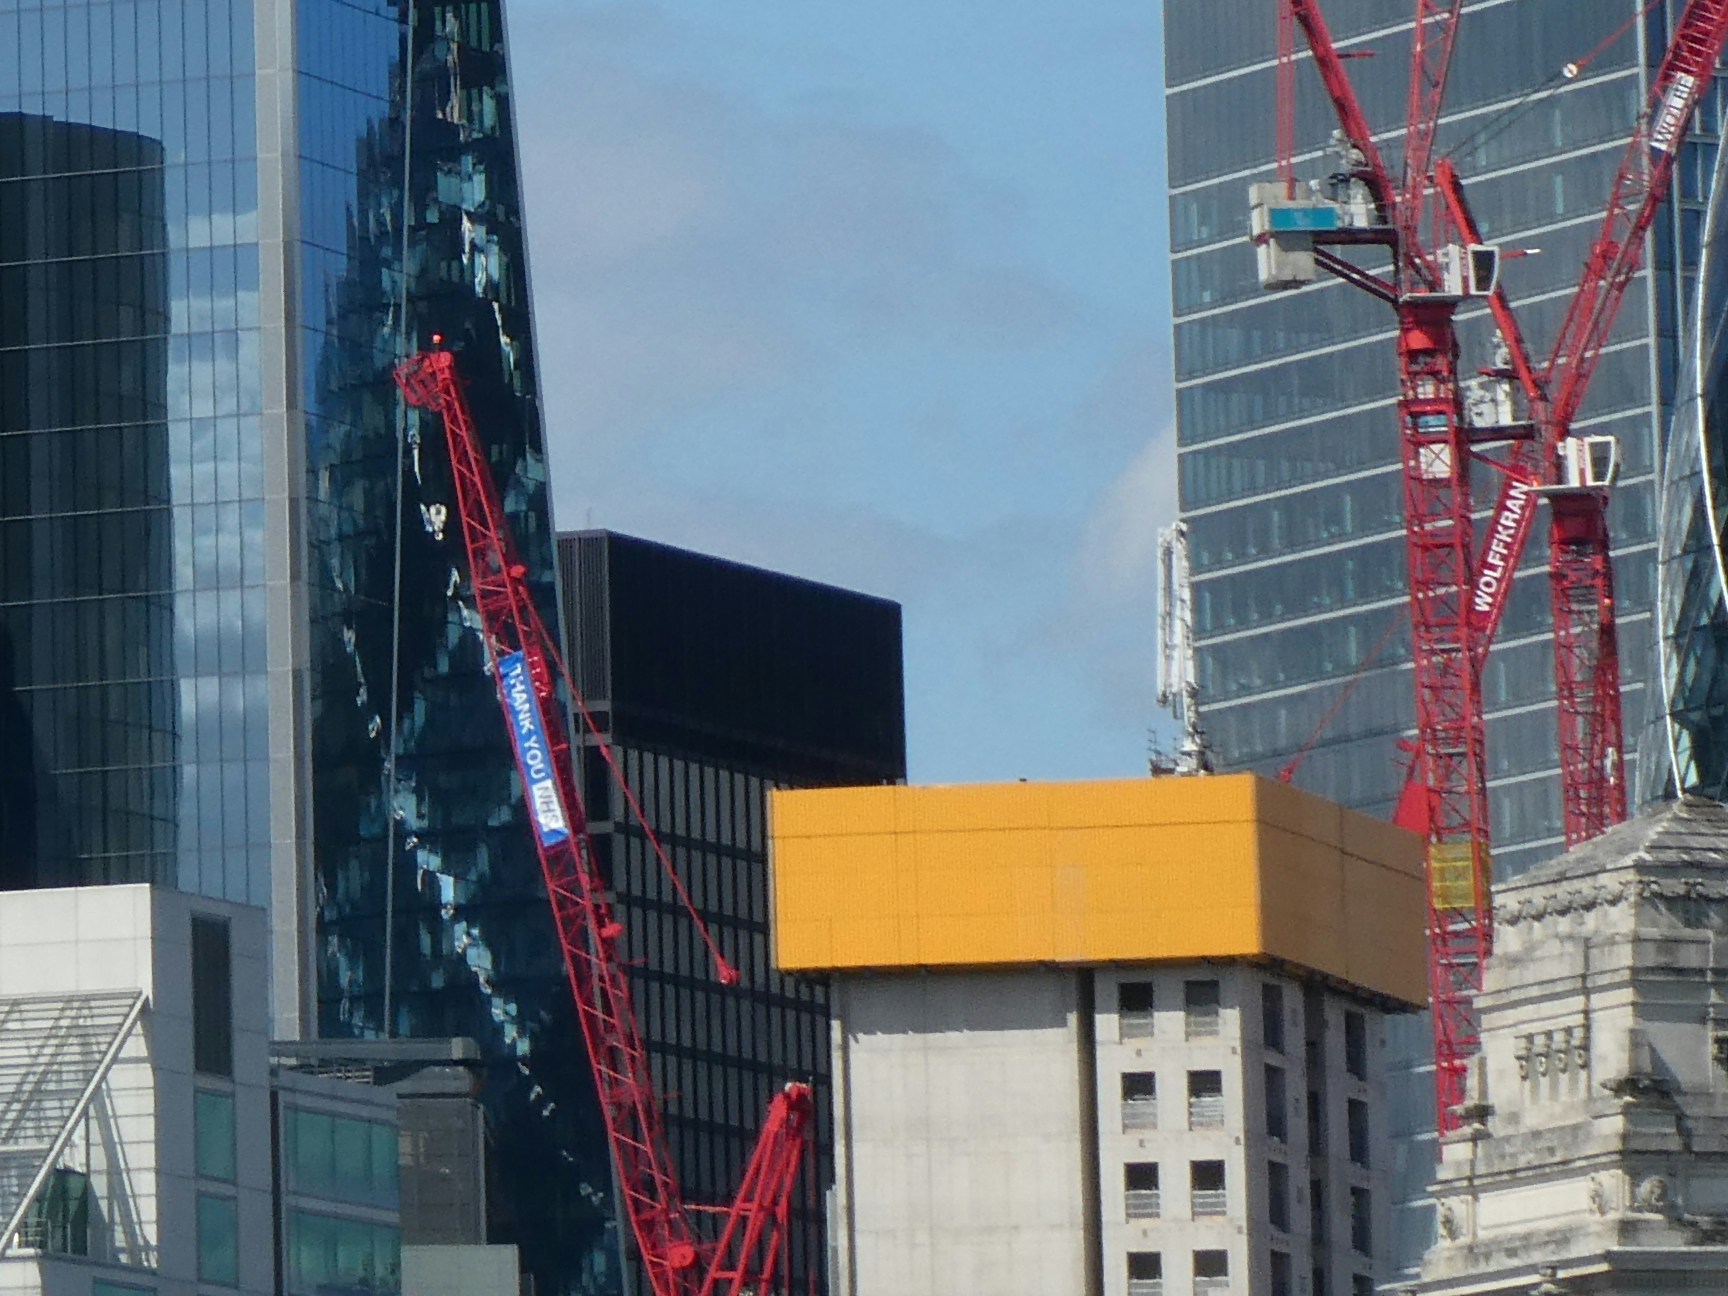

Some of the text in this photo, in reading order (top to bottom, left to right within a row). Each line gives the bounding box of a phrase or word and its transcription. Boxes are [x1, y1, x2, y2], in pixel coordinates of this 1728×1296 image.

[1474, 481, 1529, 612] WOLFFKRAN
[508, 662, 560, 827] THANK YOU NHS
